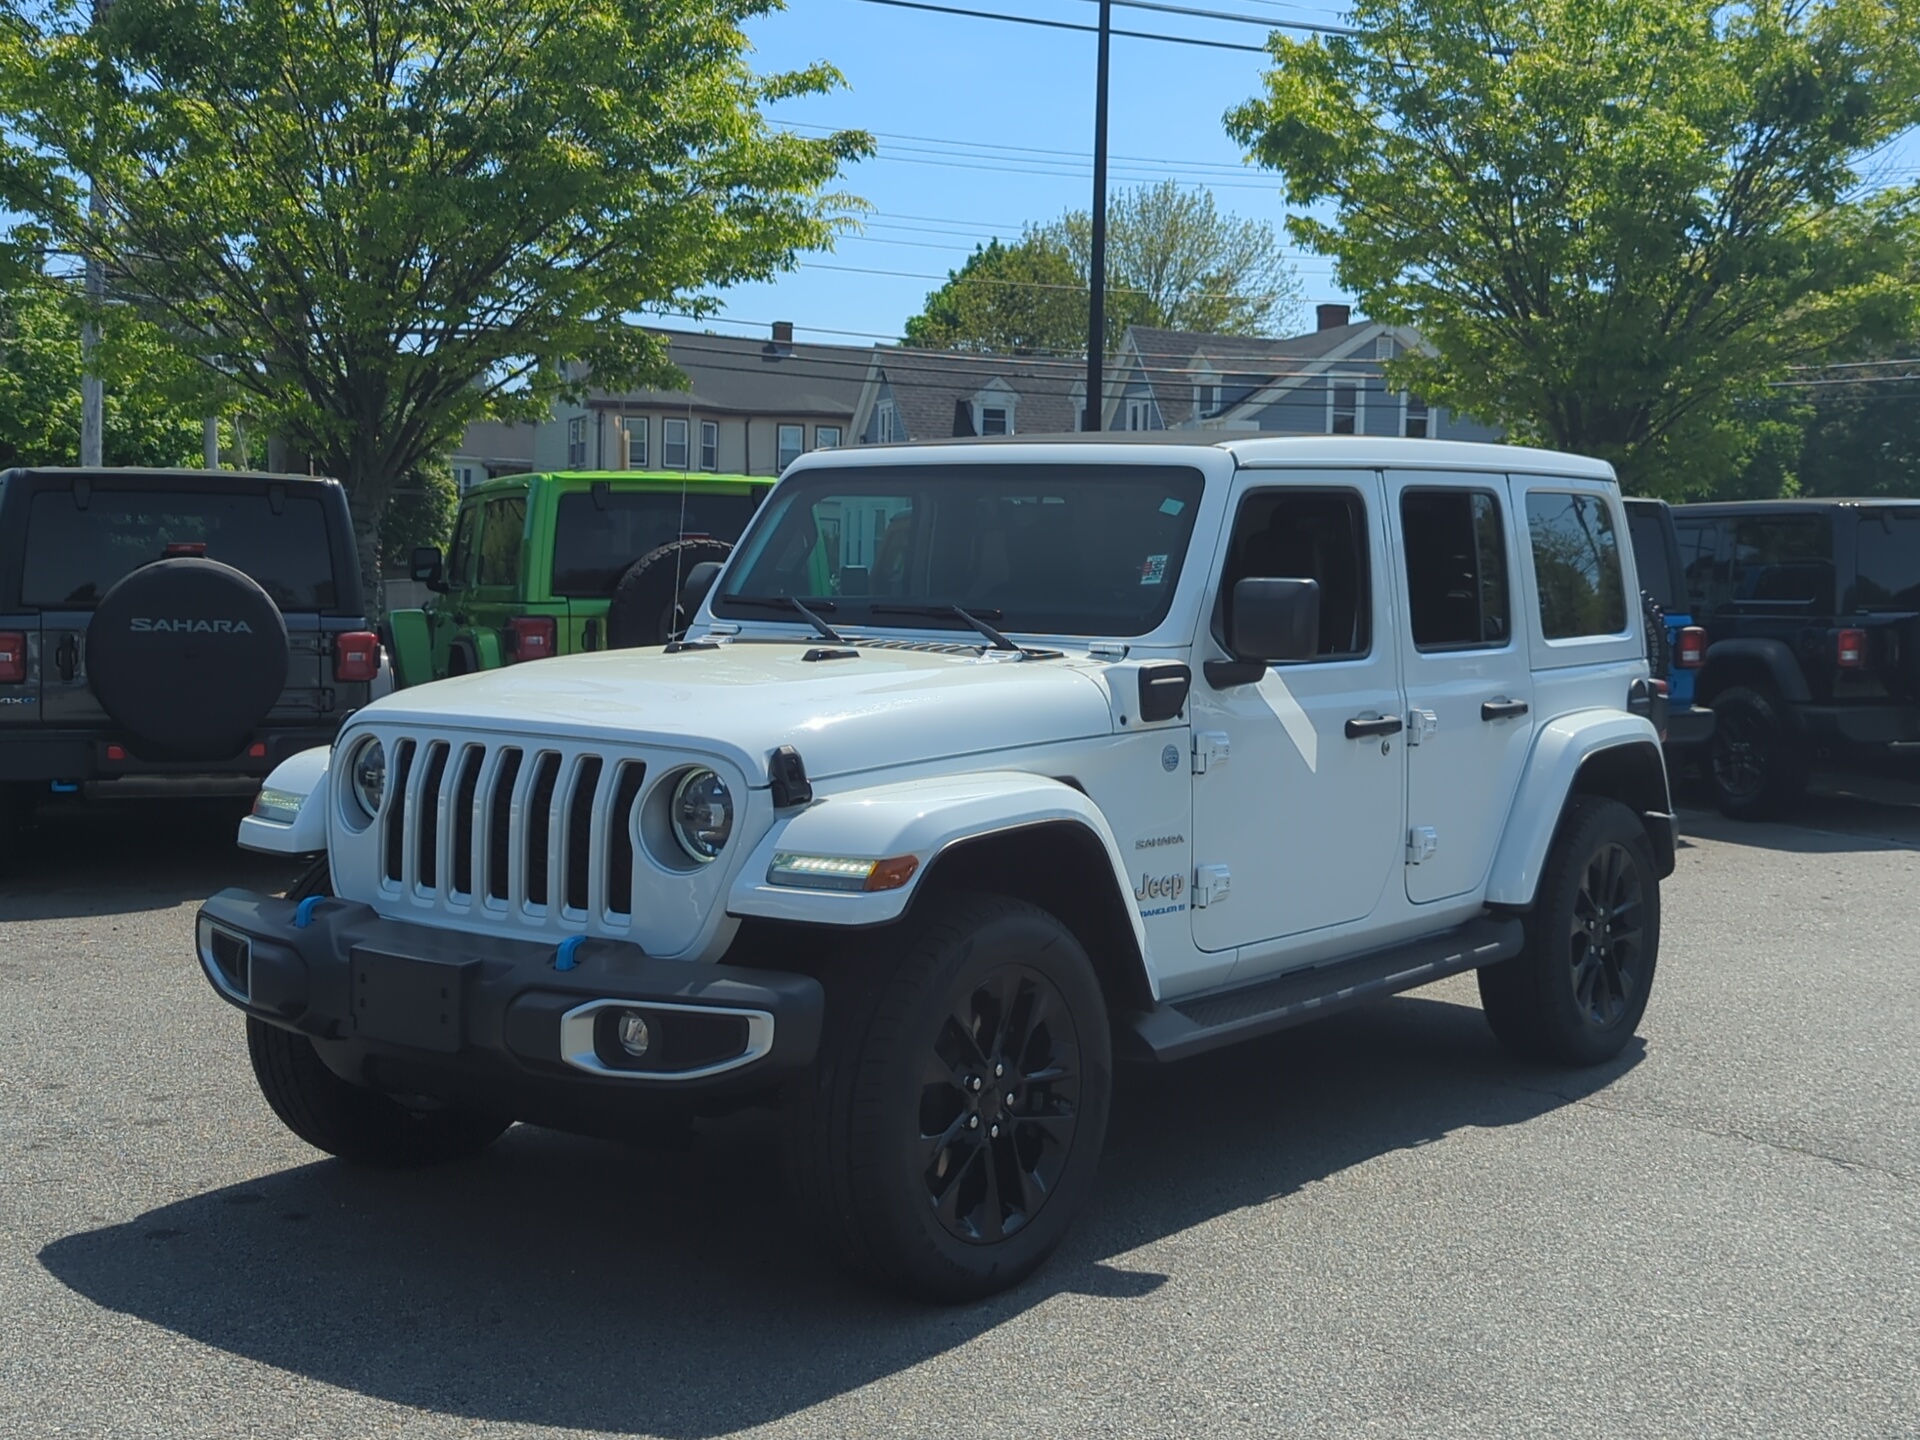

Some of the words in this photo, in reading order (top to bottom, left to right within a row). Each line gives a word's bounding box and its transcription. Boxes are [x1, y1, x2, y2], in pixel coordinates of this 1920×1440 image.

[130, 618, 253, 633] SAHARA
[1135, 834, 1184, 850] SAHARA
[1134, 872, 1184, 901] Jeep
